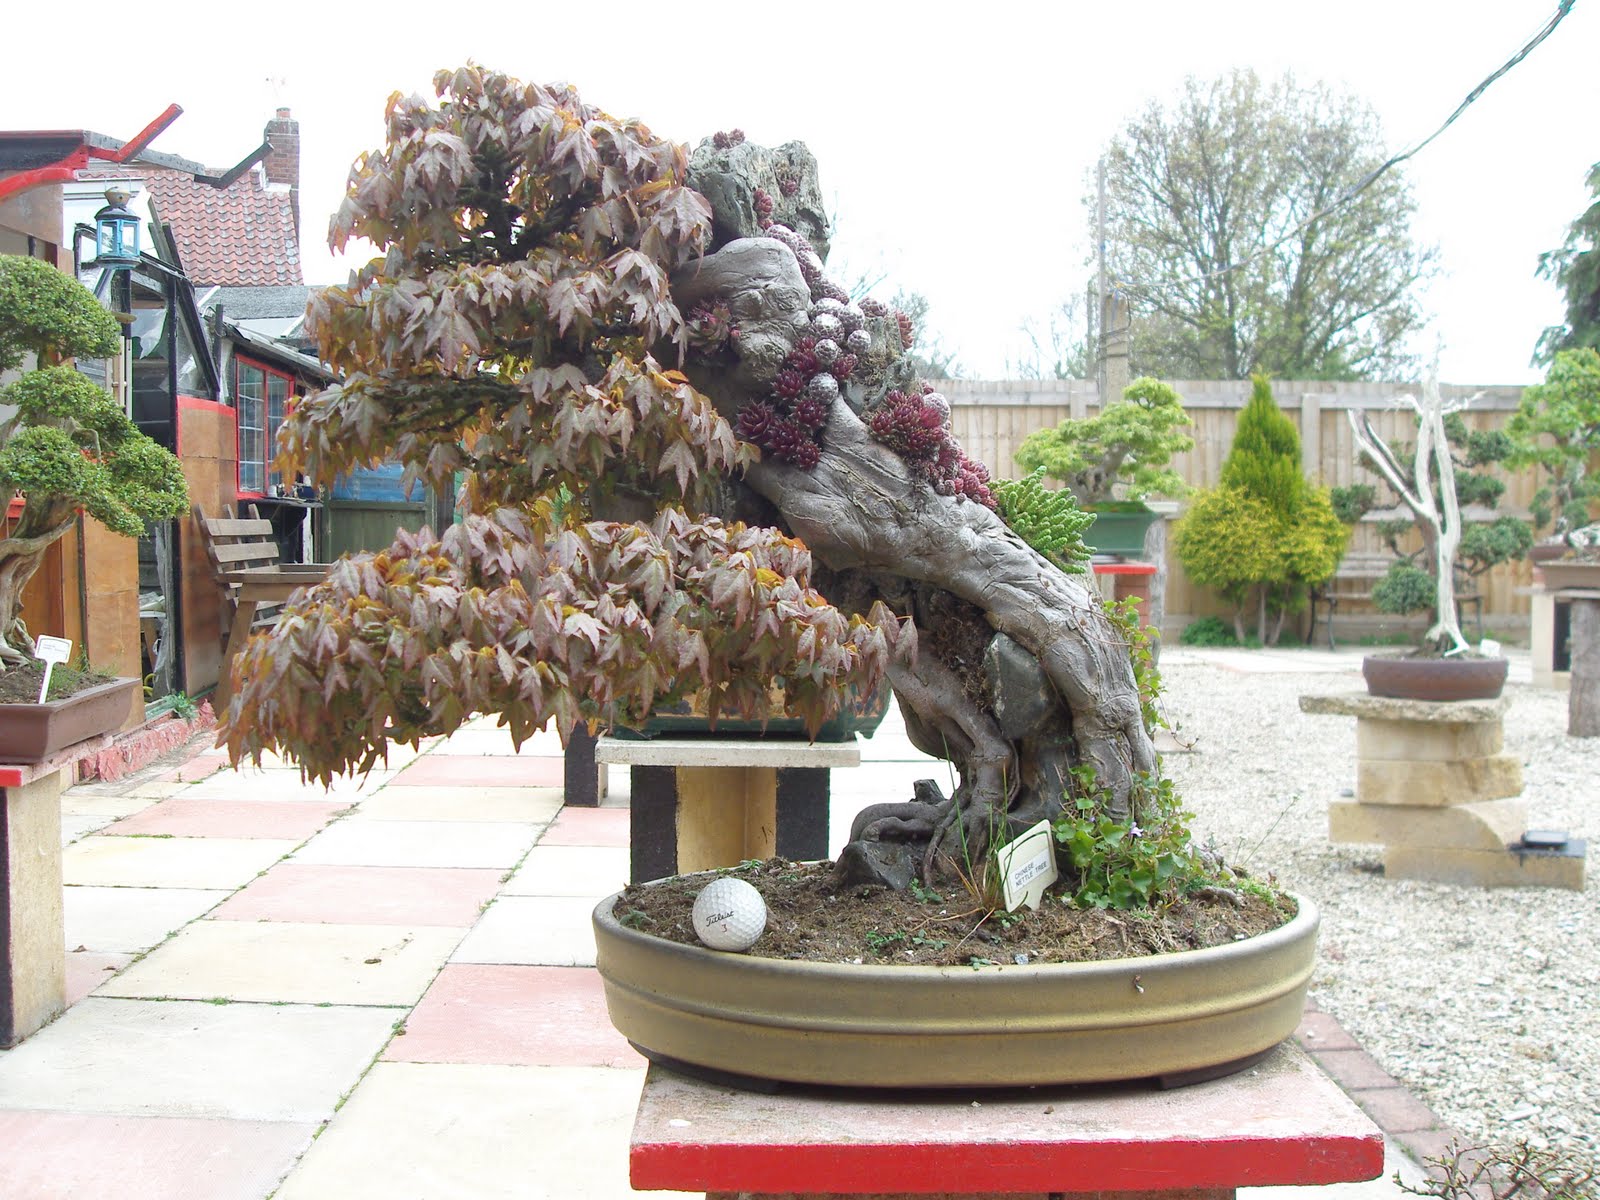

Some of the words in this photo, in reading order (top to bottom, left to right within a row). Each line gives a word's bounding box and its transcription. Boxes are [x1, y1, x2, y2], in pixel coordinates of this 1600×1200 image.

[1014, 862, 1034, 880] CHINESE
[1015, 872, 1034, 888] NETTLE
[1035, 861, 1047, 873] TREE
[706, 910, 735, 927] Titleist
[721, 923, 728, 933] 3
